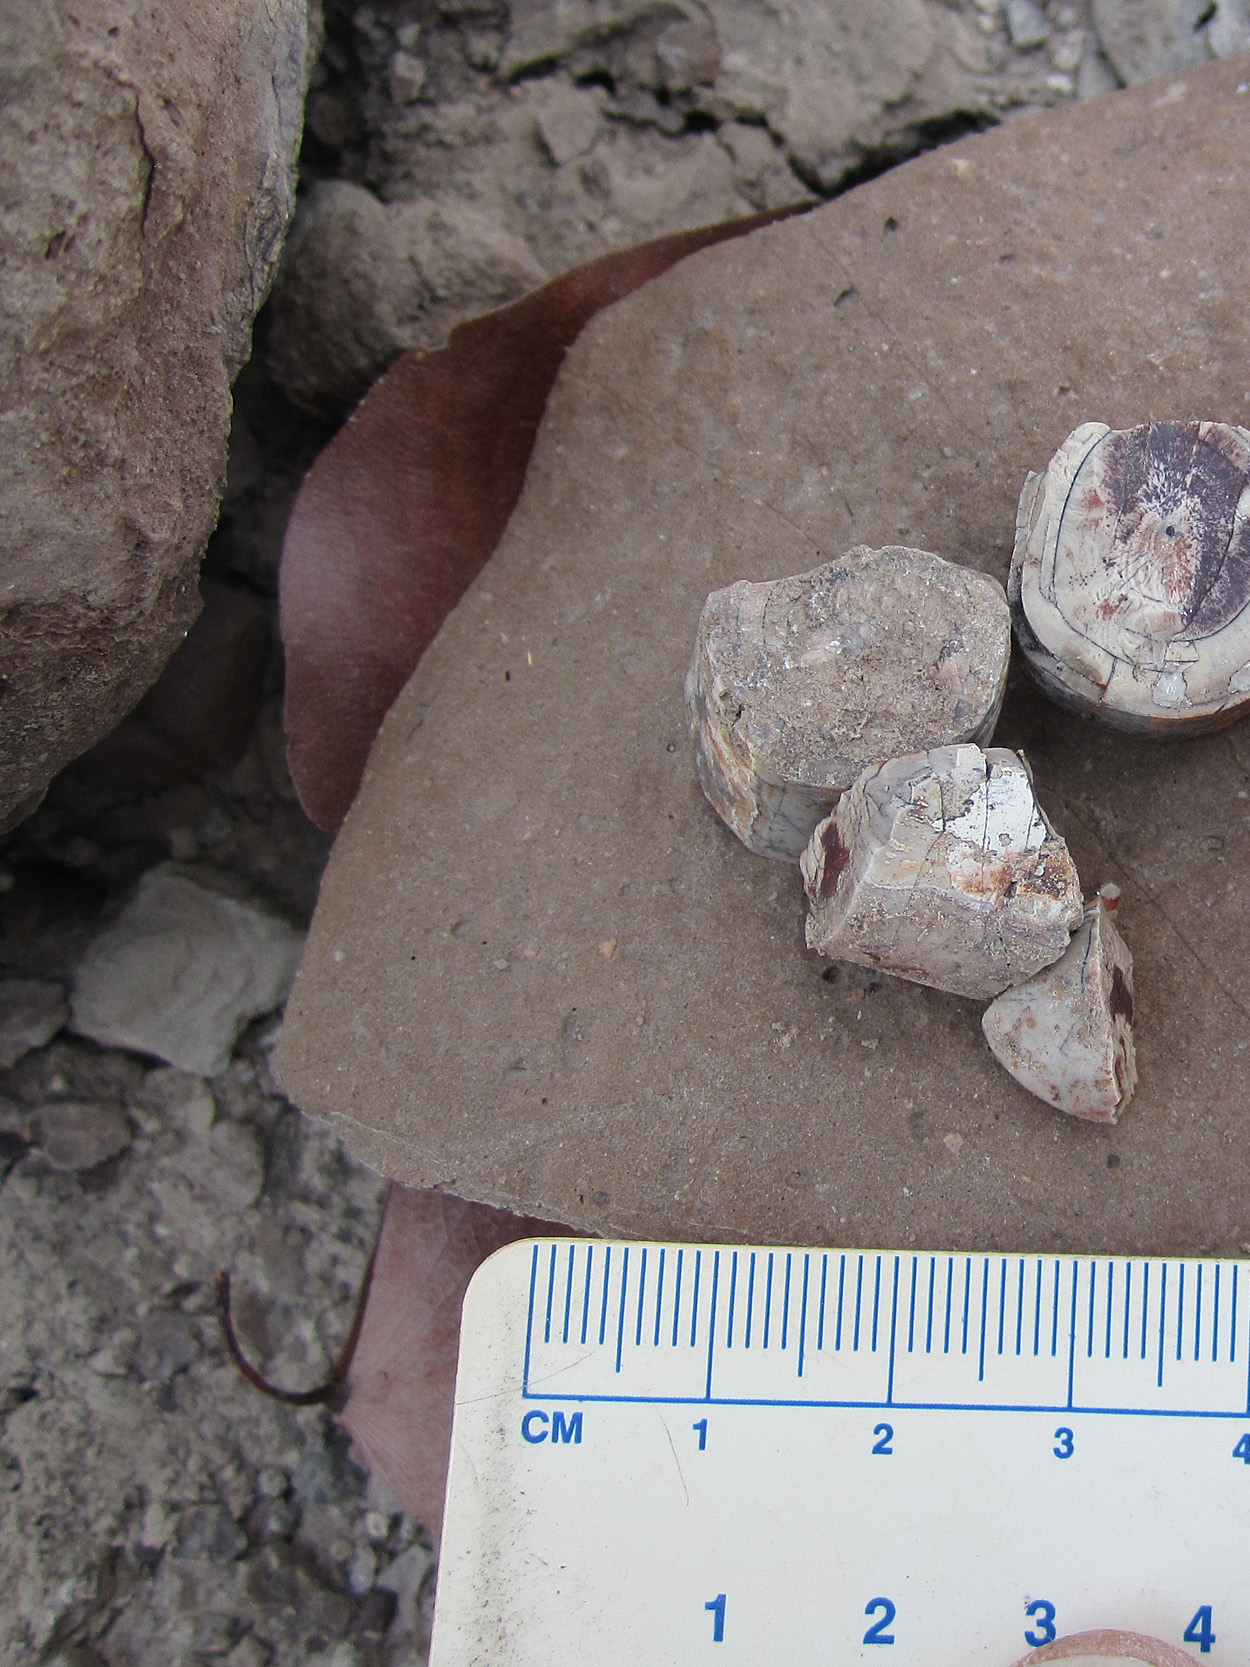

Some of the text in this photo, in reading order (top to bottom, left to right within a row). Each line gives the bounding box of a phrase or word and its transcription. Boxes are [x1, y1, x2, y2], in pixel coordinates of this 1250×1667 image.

[520, 1409, 584, 1445] CM
[692, 1418, 709, 1451] 1
[871, 1422, 894, 1456] 2
[1052, 1427, 1075, 1460] 3
[704, 1593, 727, 1643] 1
[862, 1596, 897, 1645] 2
[1024, 1599, 1057, 1648] 3
[1183, 1605, 1216, 1653] 4
